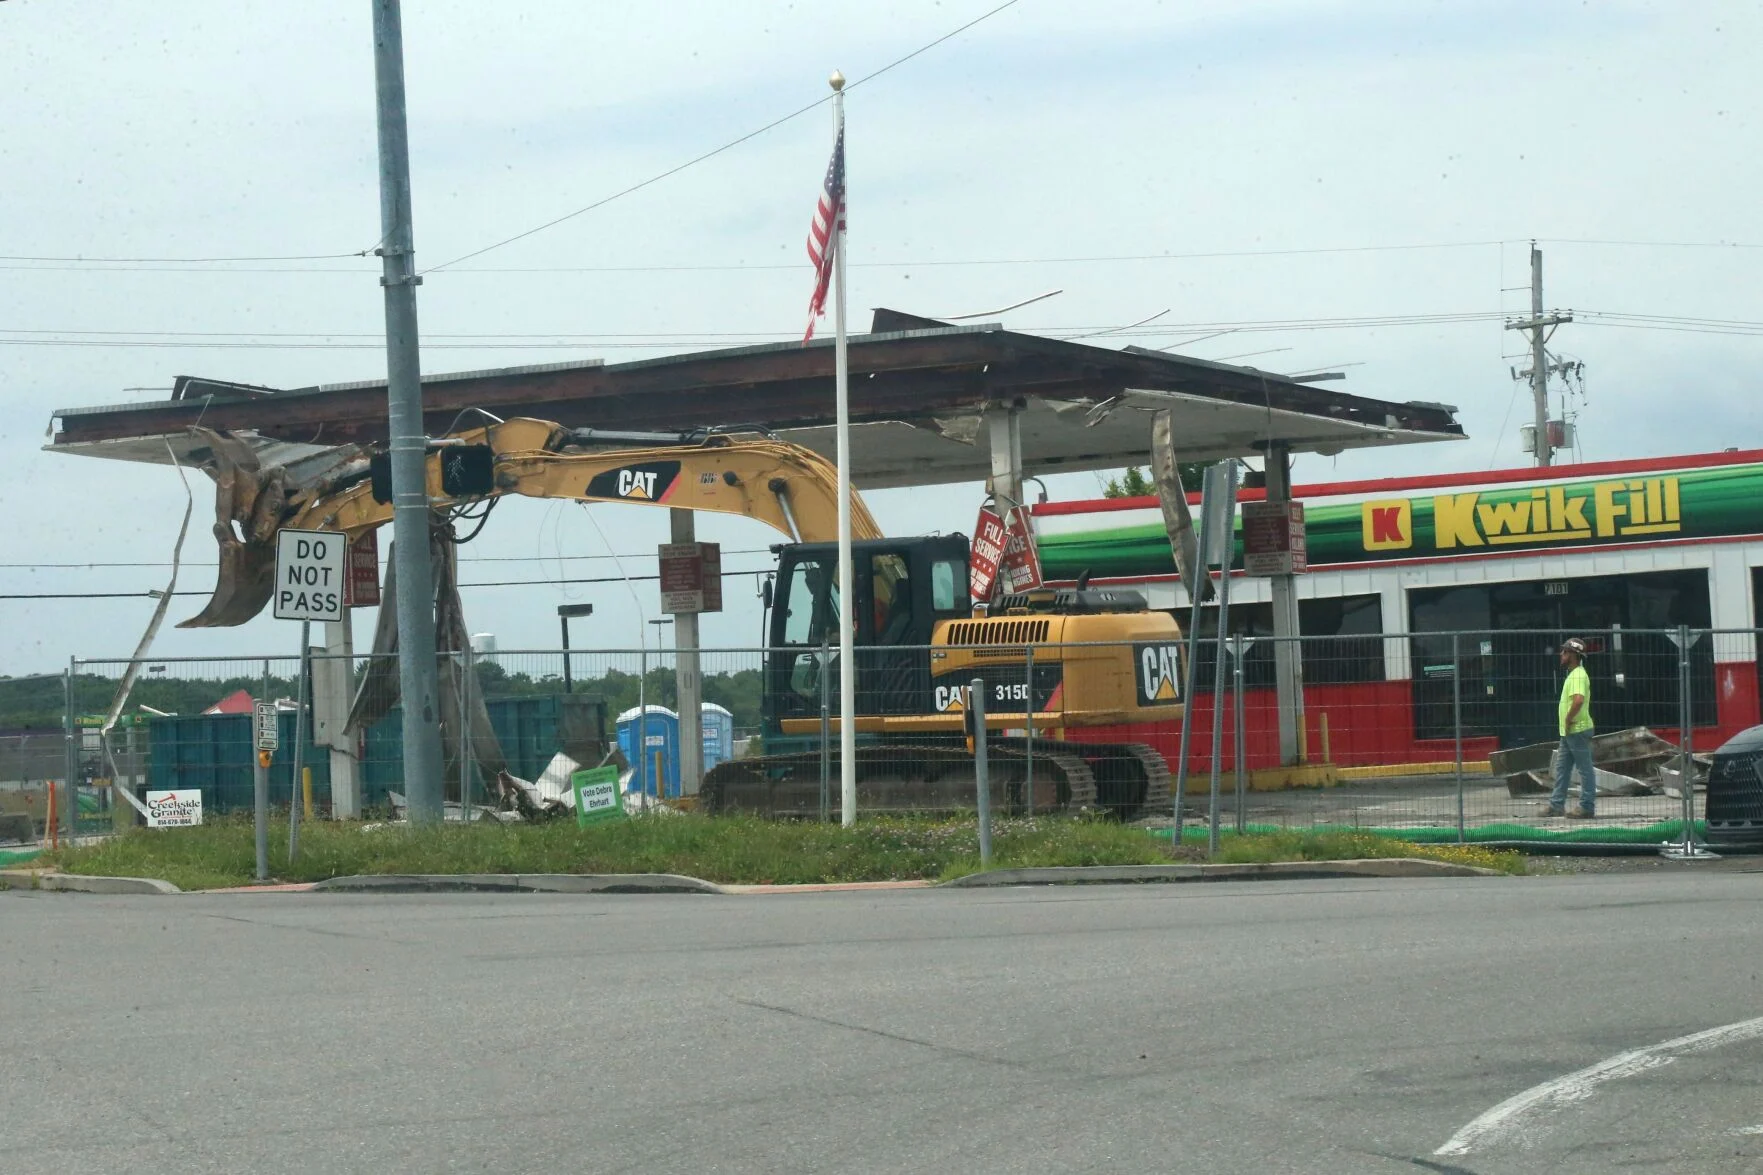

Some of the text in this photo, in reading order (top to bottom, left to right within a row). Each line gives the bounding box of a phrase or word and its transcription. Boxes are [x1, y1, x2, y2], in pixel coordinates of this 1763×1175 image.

[618, 469, 657, 499] CAT
[1372, 506, 1404, 543] K
[1434, 478, 1680, 549] Kwik Fill
[984, 521, 1003, 545] FULL
[297, 540, 326, 560] DO
[975, 538, 1001, 565] SERVICE
[288, 565, 332, 586] NOT
[280, 591, 337, 612] PASS
[1142, 647, 1179, 700] CAT
[583, 786, 613, 797] Vote Debra
[148, 800, 200, 809] Creekside
[151, 808, 192, 818] Granite
